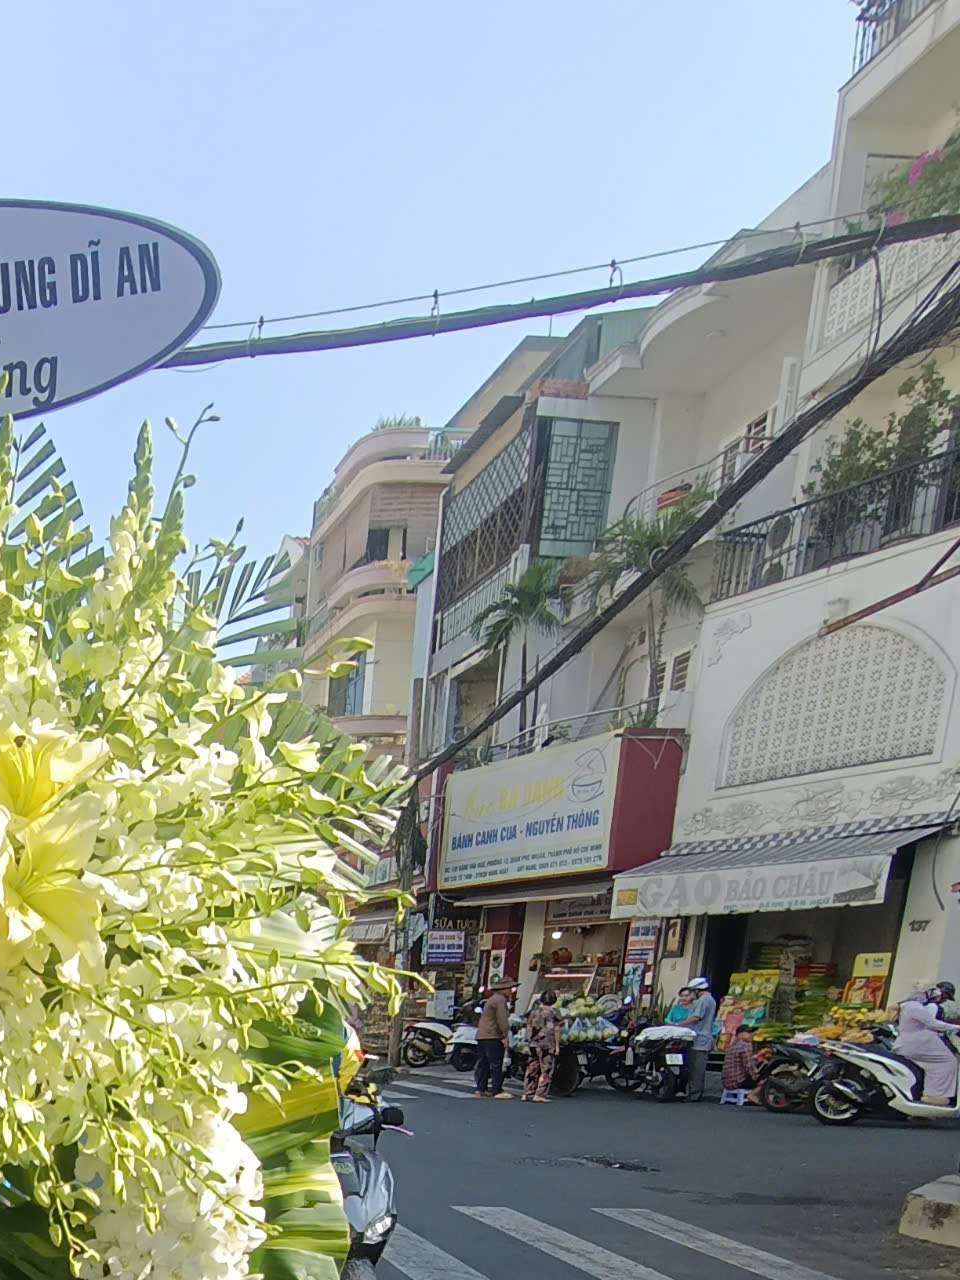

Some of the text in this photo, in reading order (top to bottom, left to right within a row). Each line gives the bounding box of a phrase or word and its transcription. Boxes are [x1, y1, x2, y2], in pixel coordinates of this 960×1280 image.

[69, 239, 101, 304] DĨ
[116, 241, 161, 298] AN
[475, 830, 498, 846] CANH
[500, 825, 517, 841] CUA
[725, 869, 768, 902] BẢO
[773, 865, 835, 900] CHÂU
[433, 916, 455, 929] SỮA
[908, 919, 932, 932] 137
